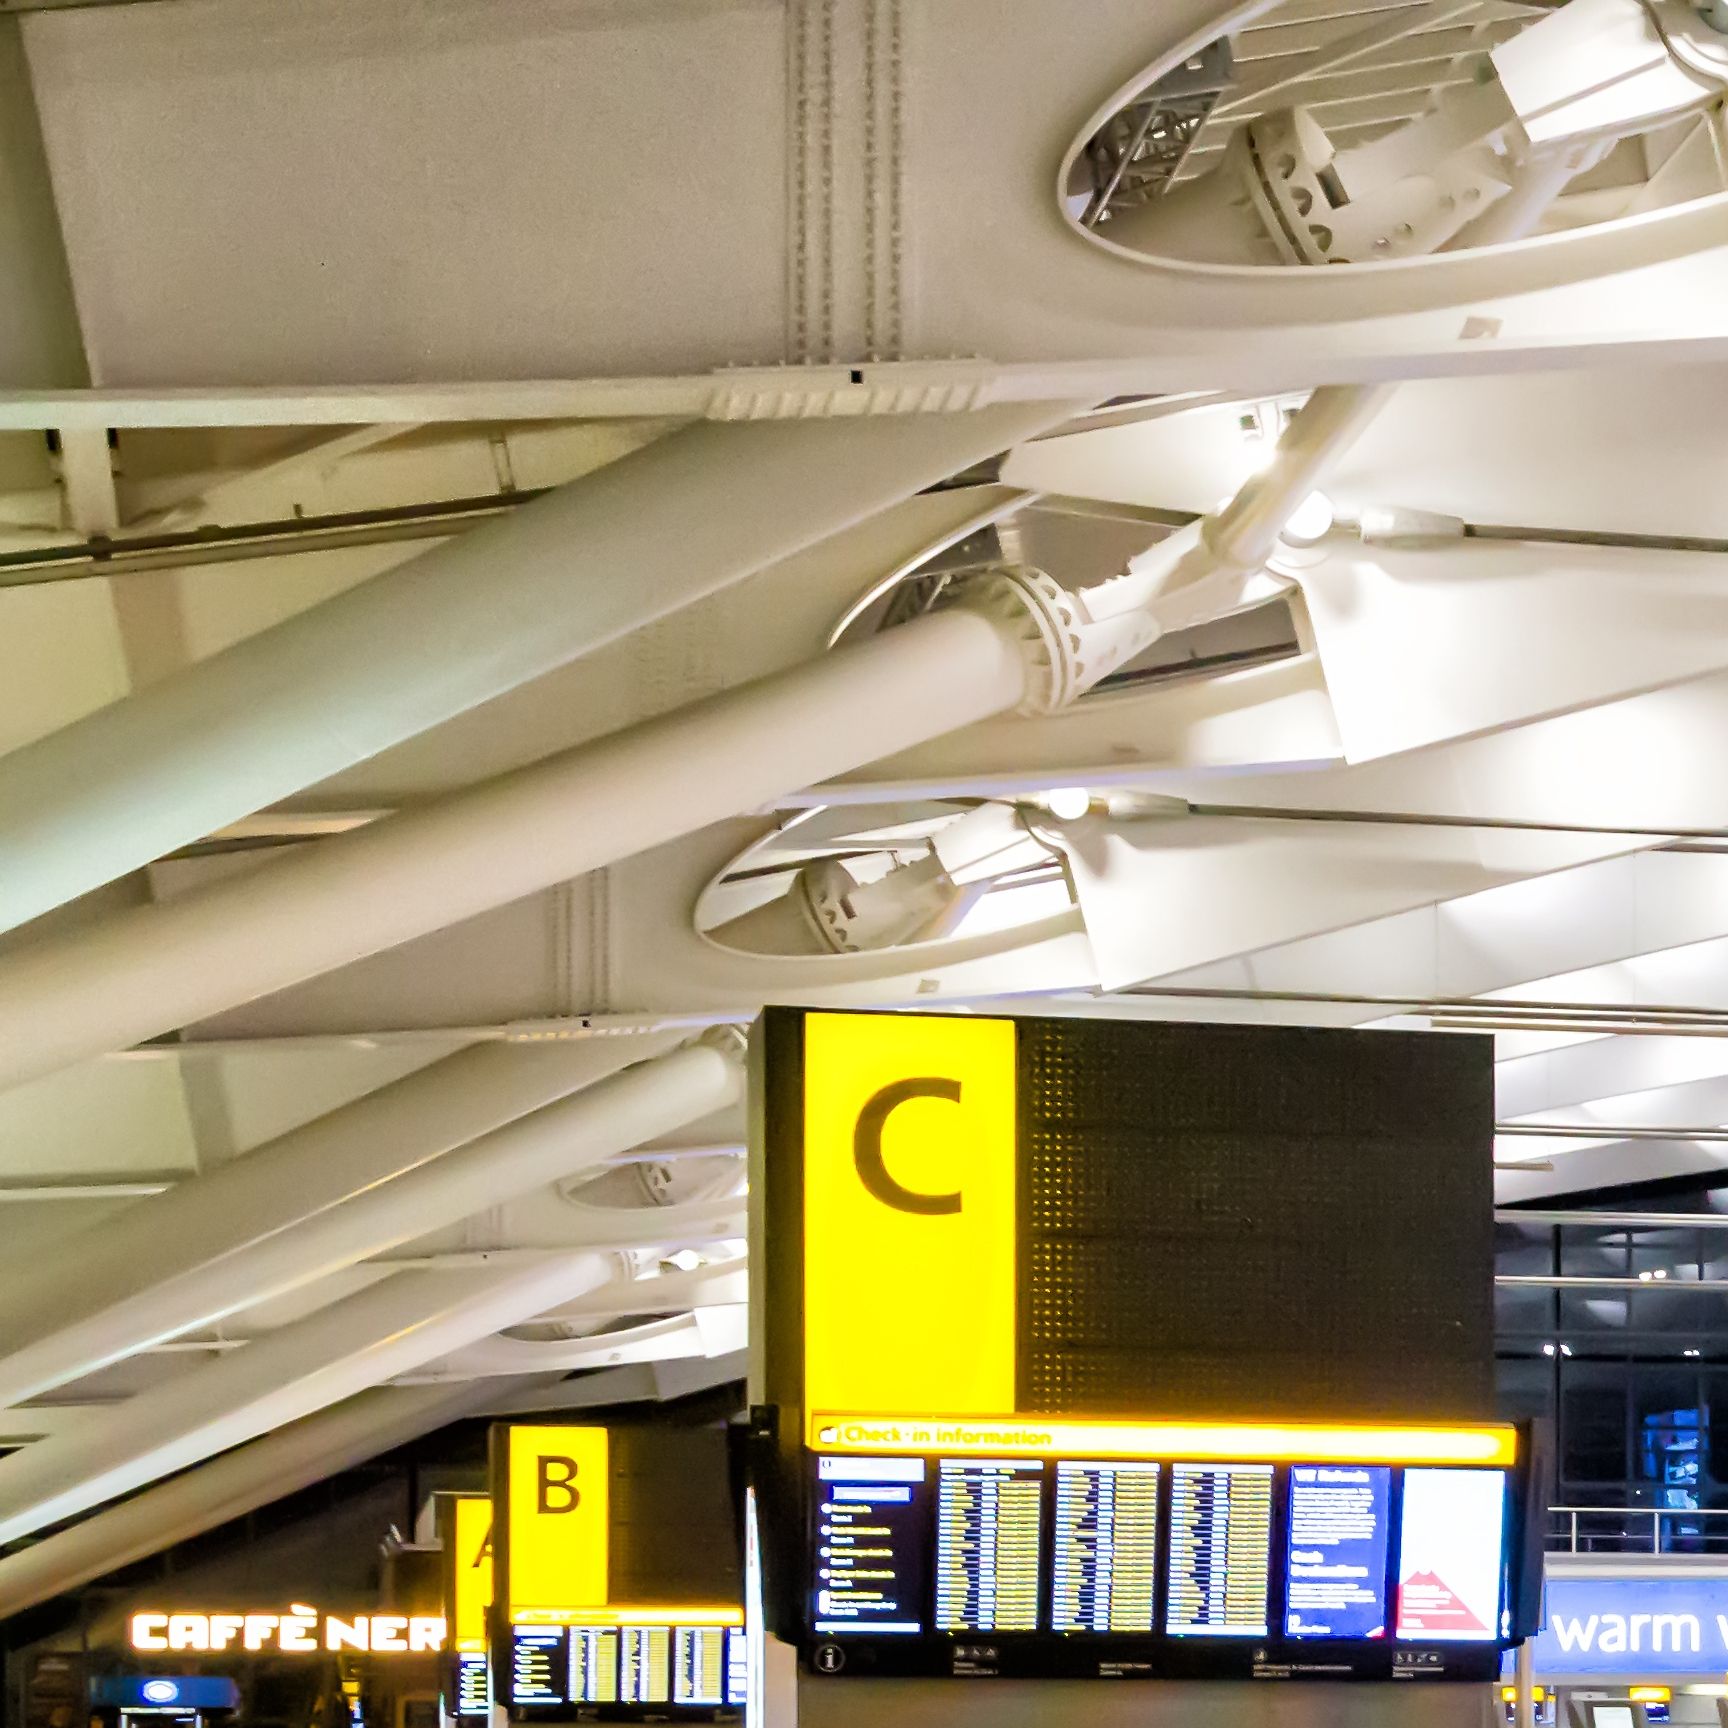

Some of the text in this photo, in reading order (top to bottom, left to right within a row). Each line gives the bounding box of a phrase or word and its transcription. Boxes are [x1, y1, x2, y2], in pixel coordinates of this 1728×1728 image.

[853, 1077, 962, 1216] C
[936, 1427, 1053, 1446] information
[537, 1455, 581, 1514] B
[131, 1603, 448, 1652] CAFFÈ NER
[1551, 1612, 1701, 1654] warm
